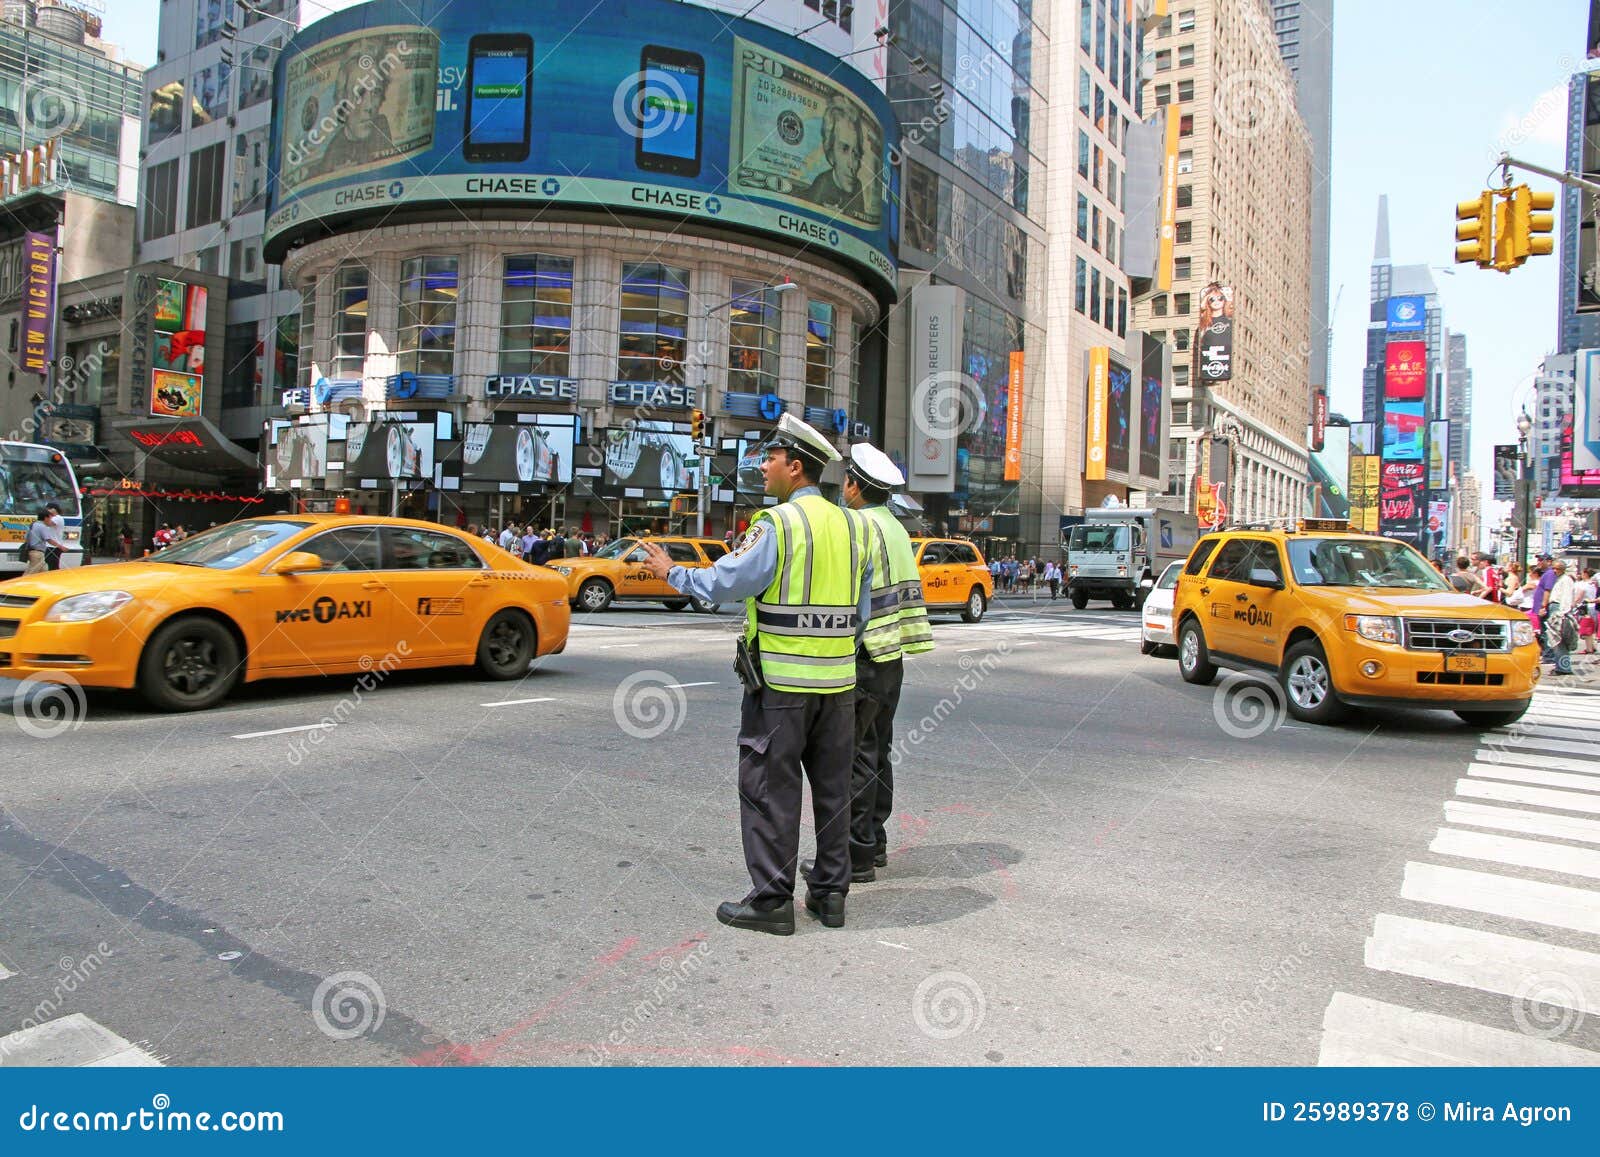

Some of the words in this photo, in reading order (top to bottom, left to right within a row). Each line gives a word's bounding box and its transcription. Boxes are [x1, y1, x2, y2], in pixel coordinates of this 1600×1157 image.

[743, 50, 784, 79] 20
[335, 185, 385, 206] CHASE
[466, 178, 537, 193] CHASE
[632, 187, 701, 210] CHASE
[778, 214, 827, 242] CHASE
[28, 238, 50, 319] VICTORY
[26, 329, 45, 369] NEW
[929, 315, 940, 369] REUTERS
[485, 376, 572, 398] CHASE
[611, 383, 697, 407] CHASE
[276, 609, 310, 623] NYC
[314, 596, 372, 623] TAXI
